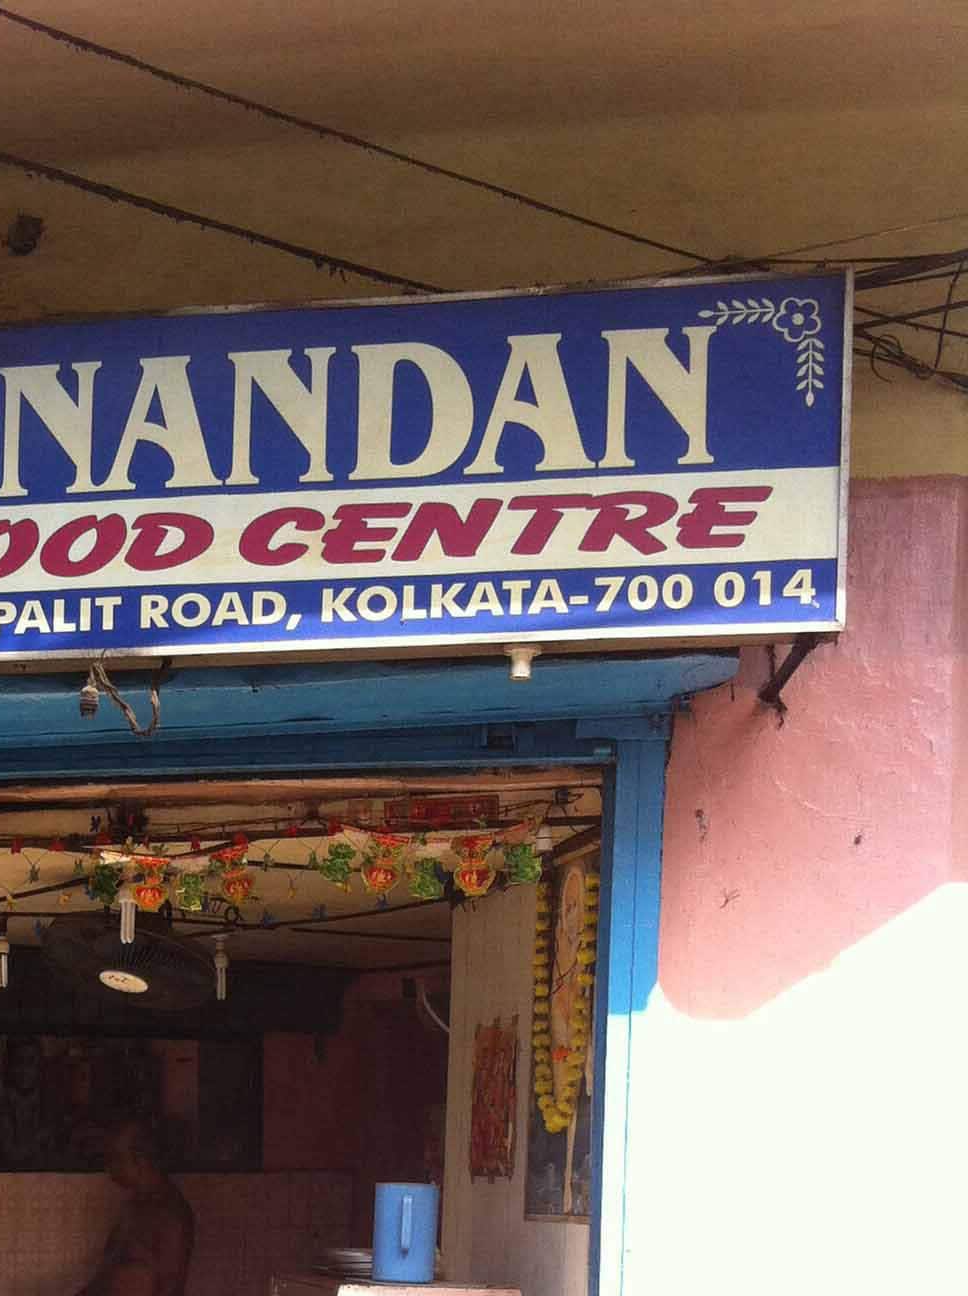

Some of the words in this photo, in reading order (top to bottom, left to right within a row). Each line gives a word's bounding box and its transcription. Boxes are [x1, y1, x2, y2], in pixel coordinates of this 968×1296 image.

[238, 486, 773, 567] CENTRE
[139, 591, 302, 631] ROAD,
[322, 573, 694, 622] KOLKATA-700
[713, 568, 817, 608] 014
